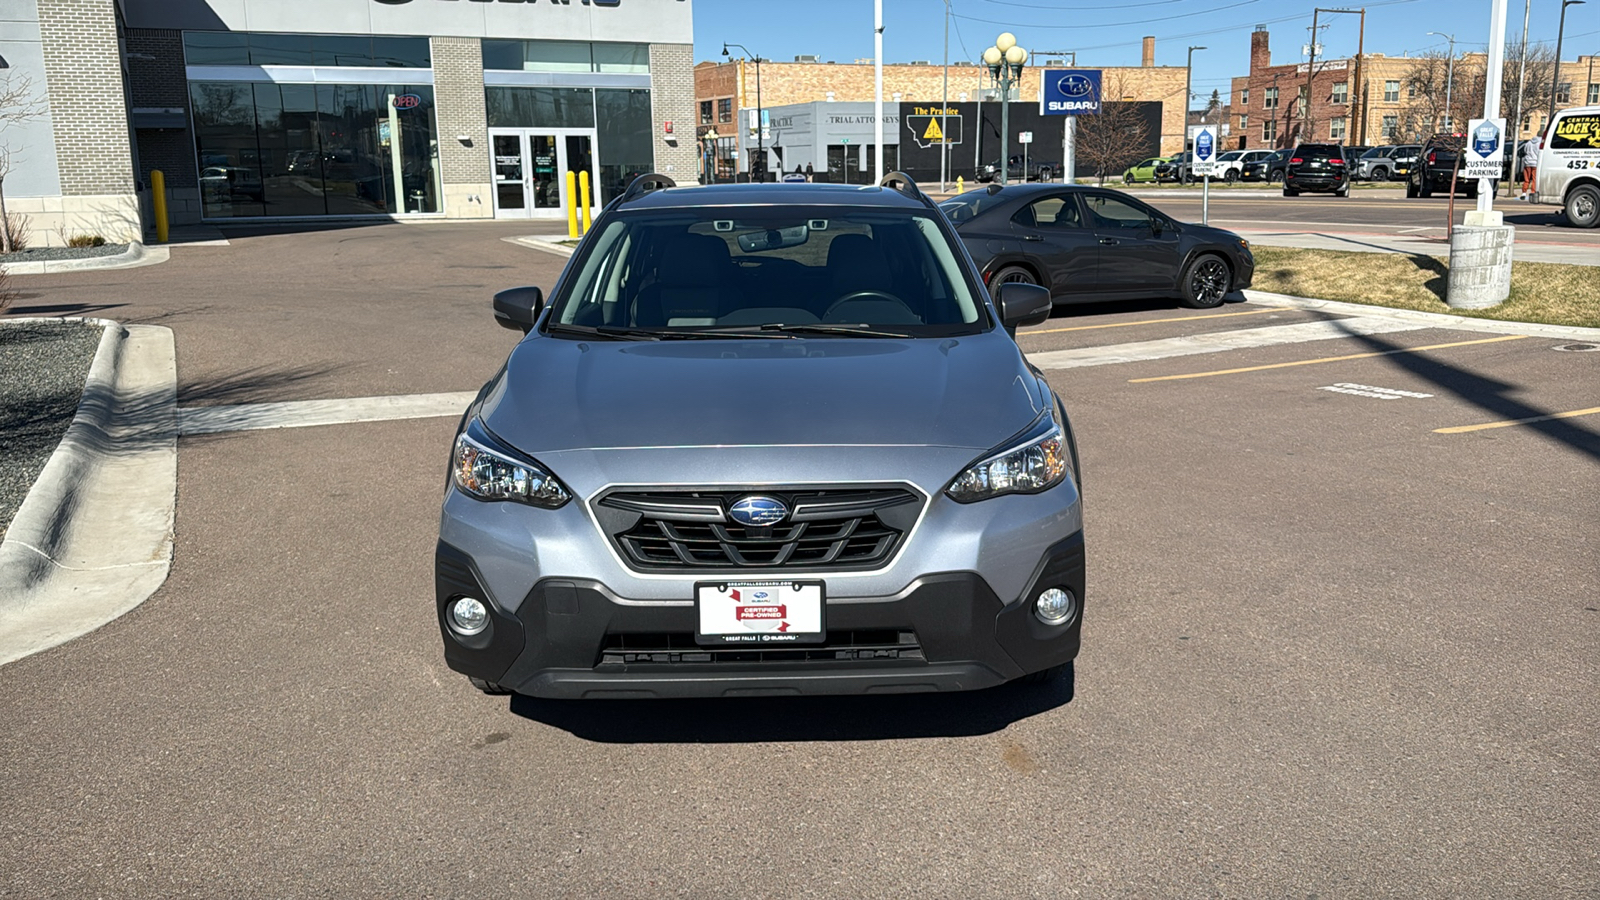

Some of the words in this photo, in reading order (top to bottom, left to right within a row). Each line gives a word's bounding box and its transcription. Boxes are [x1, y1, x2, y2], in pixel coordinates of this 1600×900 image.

[393, 96, 418, 107] OPEN
[1048, 101, 1098, 110] SUBARU
[913, 106, 928, 115] The
[930, 106, 959, 115] Pratice
[770, 117, 793, 128] PRACTICE
[829, 116, 854, 124] TRIAL
[1556, 121, 1591, 134] LOCK
[1466, 160, 1503, 168] CUSTOMER
[1567, 160, 1588, 169] 452
